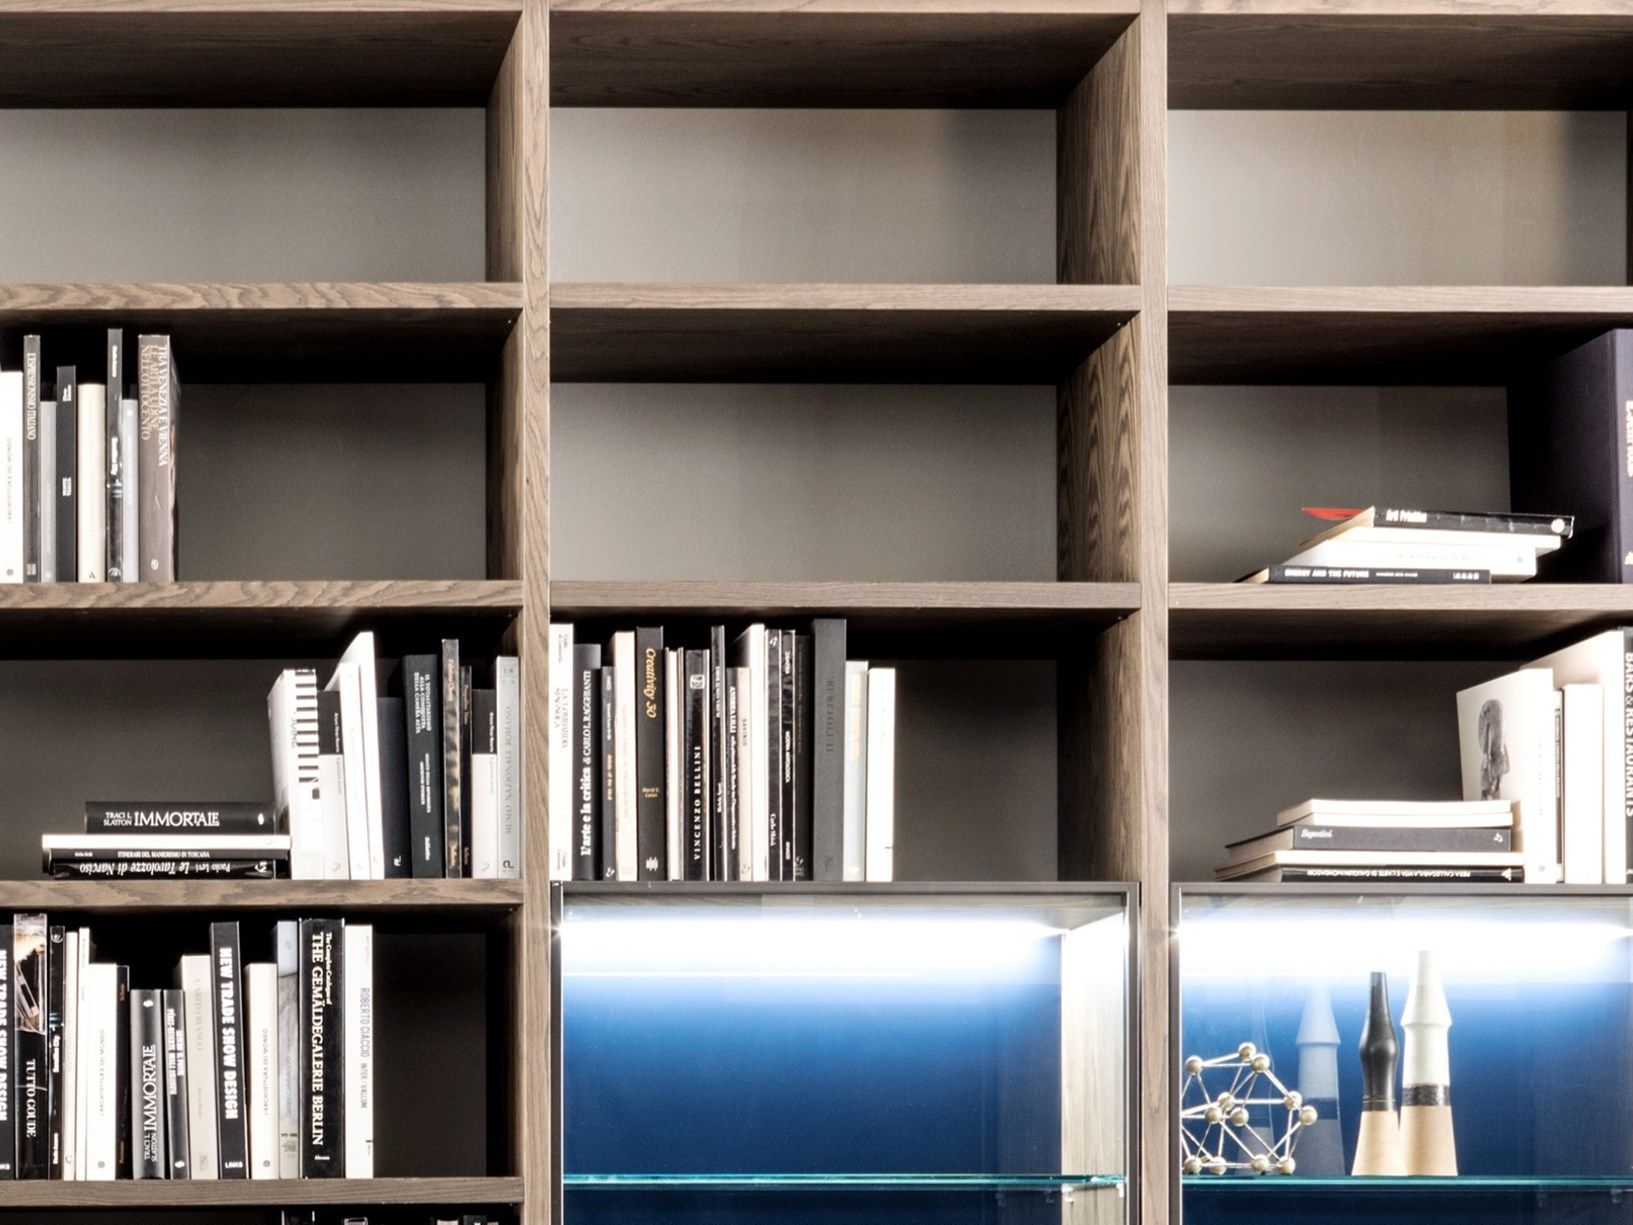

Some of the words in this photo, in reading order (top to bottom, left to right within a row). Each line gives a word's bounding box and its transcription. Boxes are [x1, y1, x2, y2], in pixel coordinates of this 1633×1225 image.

[158, 345, 166, 365] TRA
[141, 345, 150, 440] NELL'OTTOCENTO
[158, 366, 167, 413] VENEZIA
[159, 425, 167, 466] VIENNA
[1312, 569, 1327, 578] AND
[1328, 569, 1342, 578] THE
[1343, 570, 1369, 578] FUTURE
[644, 648, 656, 699] Creativity
[646, 701, 656, 718] 30
[583, 730, 591, 756] CARLO
[1625, 708, 1633, 817] RESTAURANTS
[580, 767, 591, 801] critica
[134, 812, 220, 827] IMMORTALE
[580, 803, 591, 814] la
[580, 824, 591, 855] L'arte
[80, 862, 116, 874] Narciso
[118, 862, 128, 875] di
[131, 863, 177, 875] Tavolozze
[179, 862, 189, 874] Le
[195, 863, 205, 872] Levi
[210, 863, 230, 873] Paolo
[219, 948, 232, 978] NEW
[312, 932, 323, 963] THE
[221, 982, 234, 1023] TRADE
[360, 988, 369, 1024] ROBERTO
[312, 966, 326, 1091] GEMÄLDEGALERIE
[360, 1026, 369, 1057] CIACCIO
[223, 1028, 235, 1066] SHOW
[26, 1059, 36, 1097] TUTTO
[143, 1045, 157, 1131] IMMORTALE
[224, 1071, 237, 1119] DESIGN
[26, 1099, 37, 1138] GOUDE
[312, 1095, 323, 1145] BERLIN
